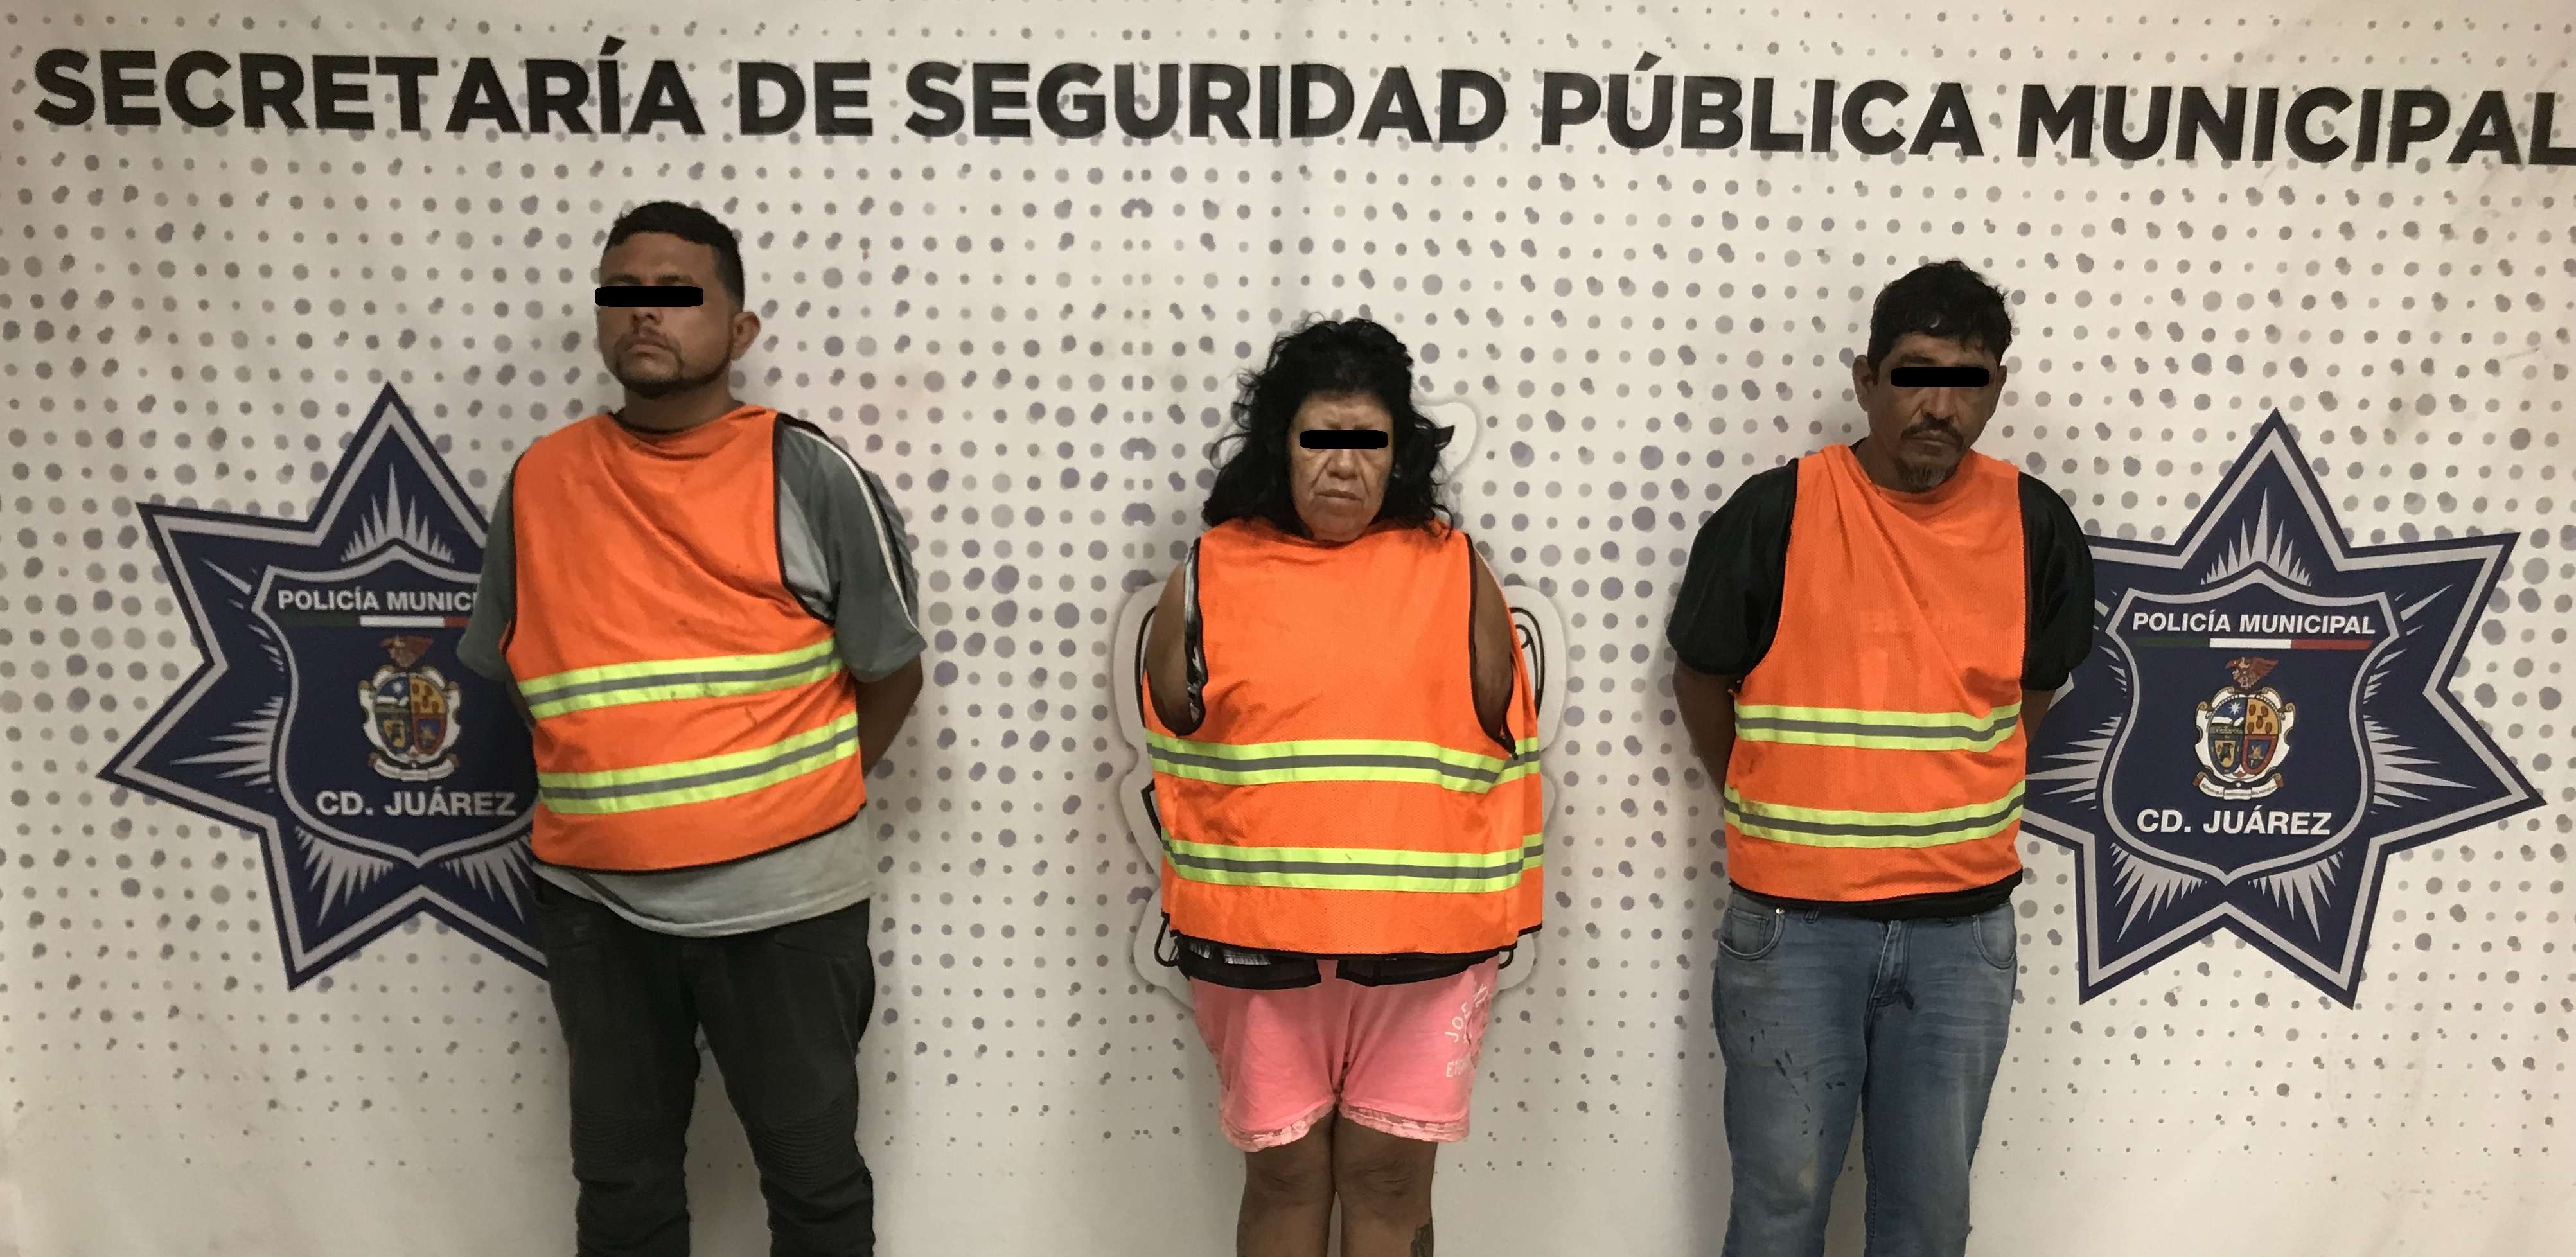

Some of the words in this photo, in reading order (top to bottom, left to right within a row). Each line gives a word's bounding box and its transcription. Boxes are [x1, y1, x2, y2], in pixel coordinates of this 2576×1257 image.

[35, 35, 705, 135] SECRETARÍA
[738, 62, 873, 136] DE
[904, 62, 1507, 143] SEGURIDAD
[1541, 51, 1985, 156] PÚBLICA
[2016, 84, 2576, 166] MUNICIPAL
[278, 585, 380, 611] POLICÍA
[386, 590, 479, 612] MUNICI
[2133, 609, 2231, 633] POLICÍA
[2239, 614, 2376, 634] MUNICIPAL
[315, 790, 373, 816] CD.
[384, 785, 516, 816] JUÁREZ
[2137, 808, 2191, 833] CD.
[2203, 804, 2333, 835] JUÁREZ
